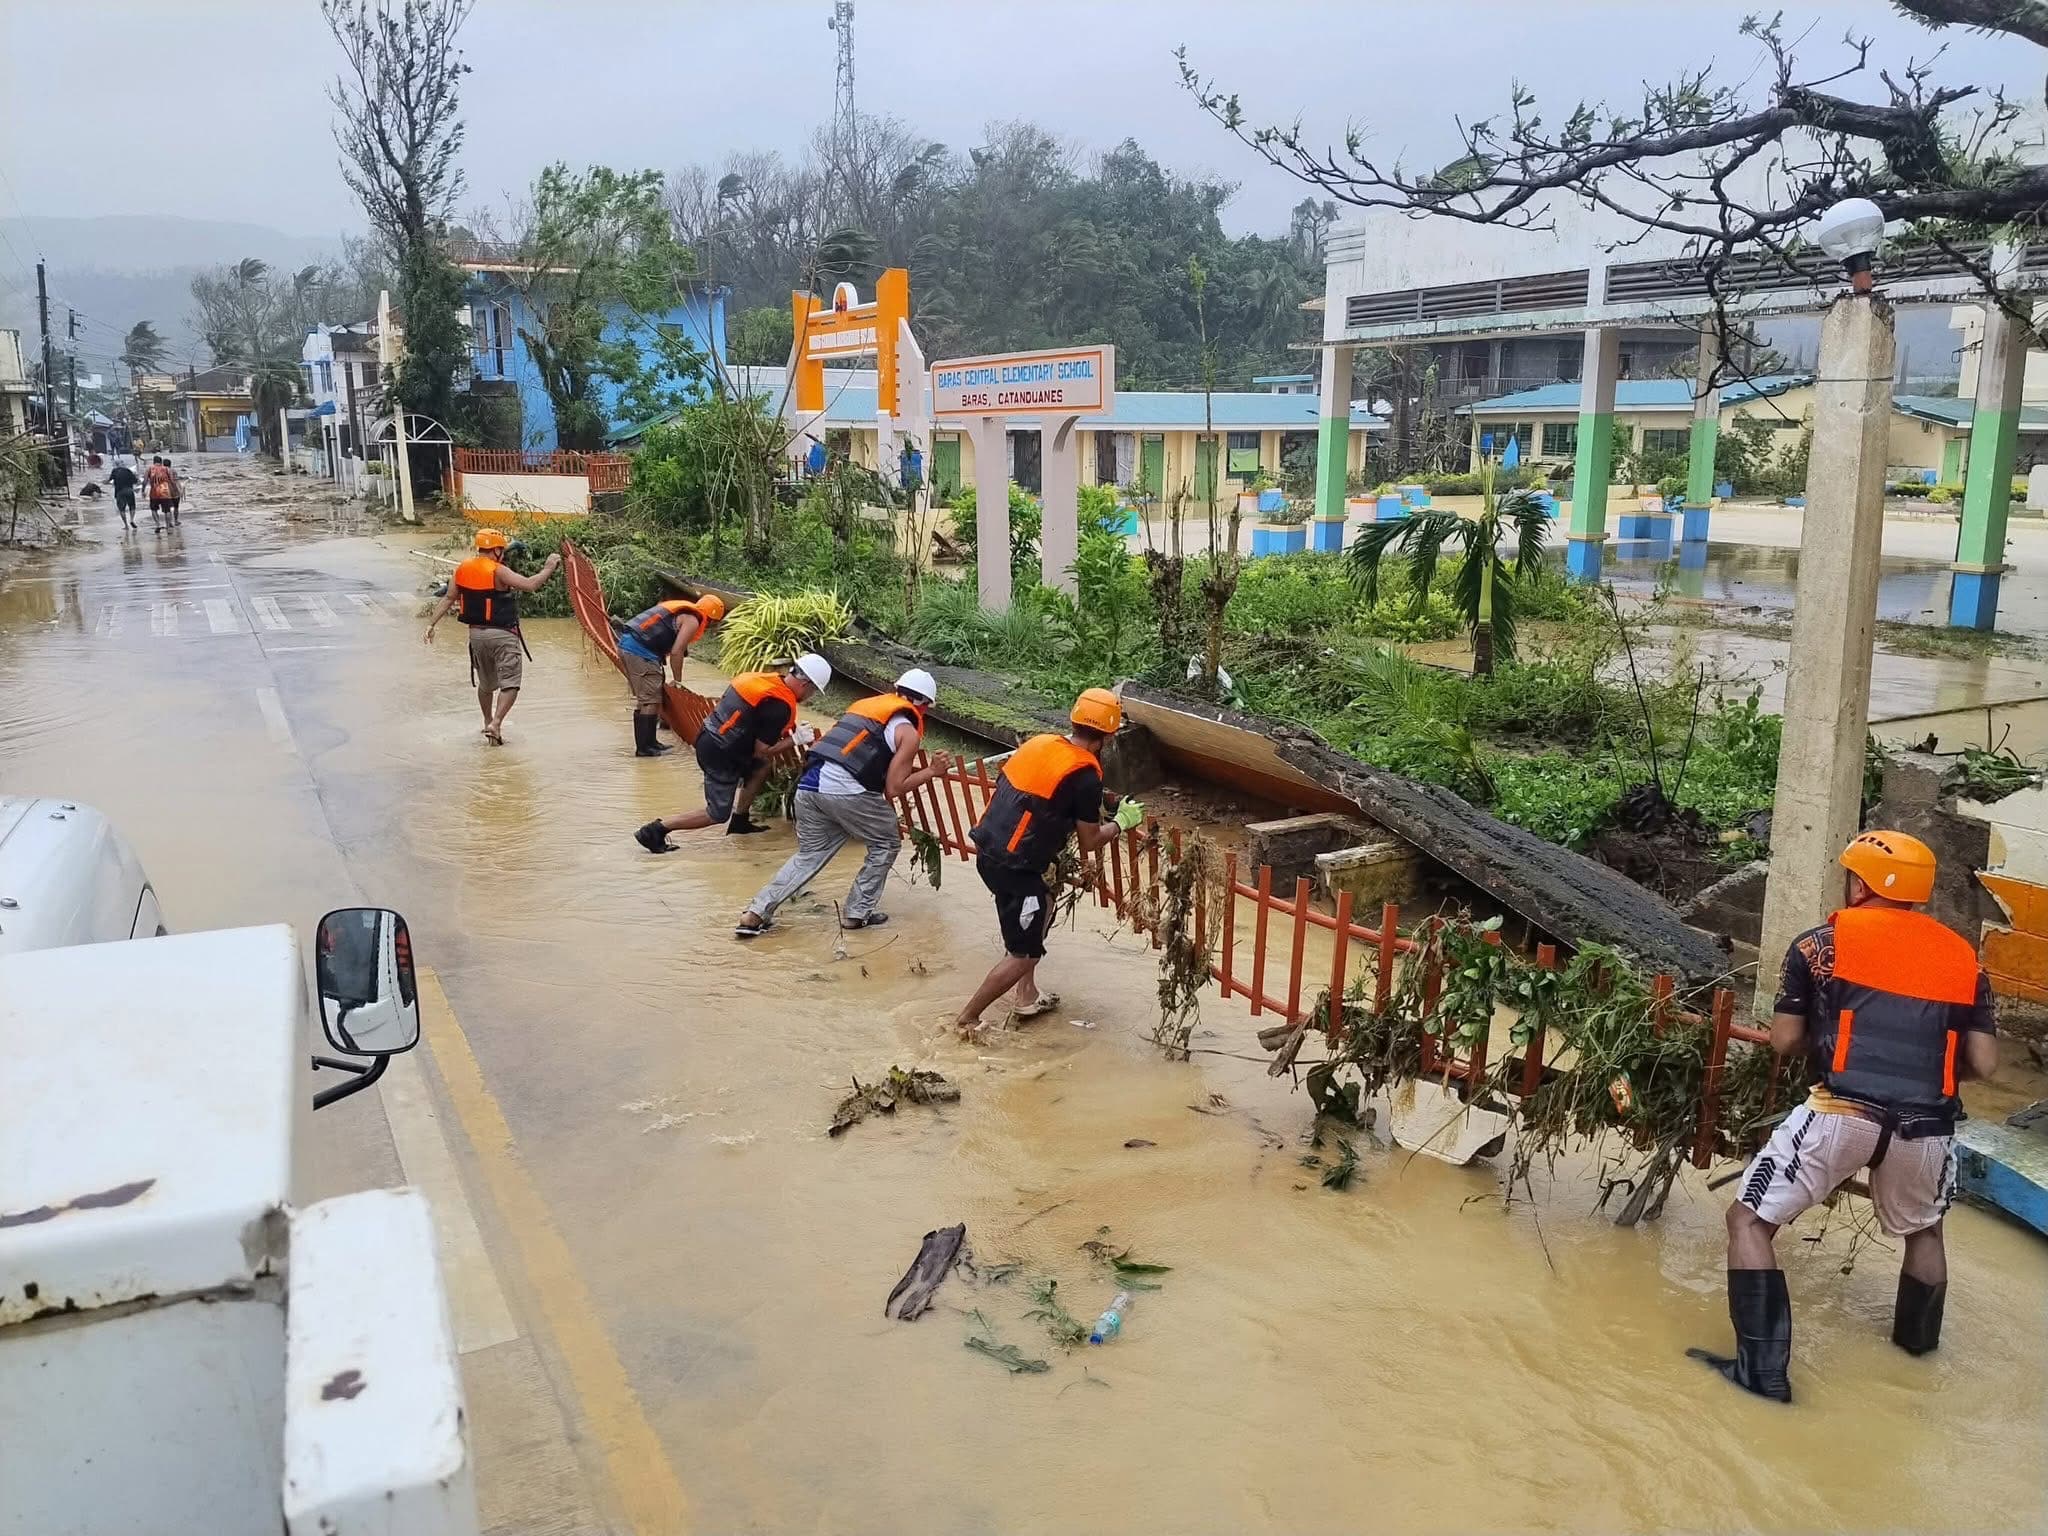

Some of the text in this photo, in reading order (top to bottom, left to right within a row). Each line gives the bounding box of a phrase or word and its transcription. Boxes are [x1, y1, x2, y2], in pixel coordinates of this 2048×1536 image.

[938, 360, 1094, 388] BARAS CENTRAL ELEMENTARY SCHOOL
[961, 389, 1063, 407] BARAS, CATANDUANES
